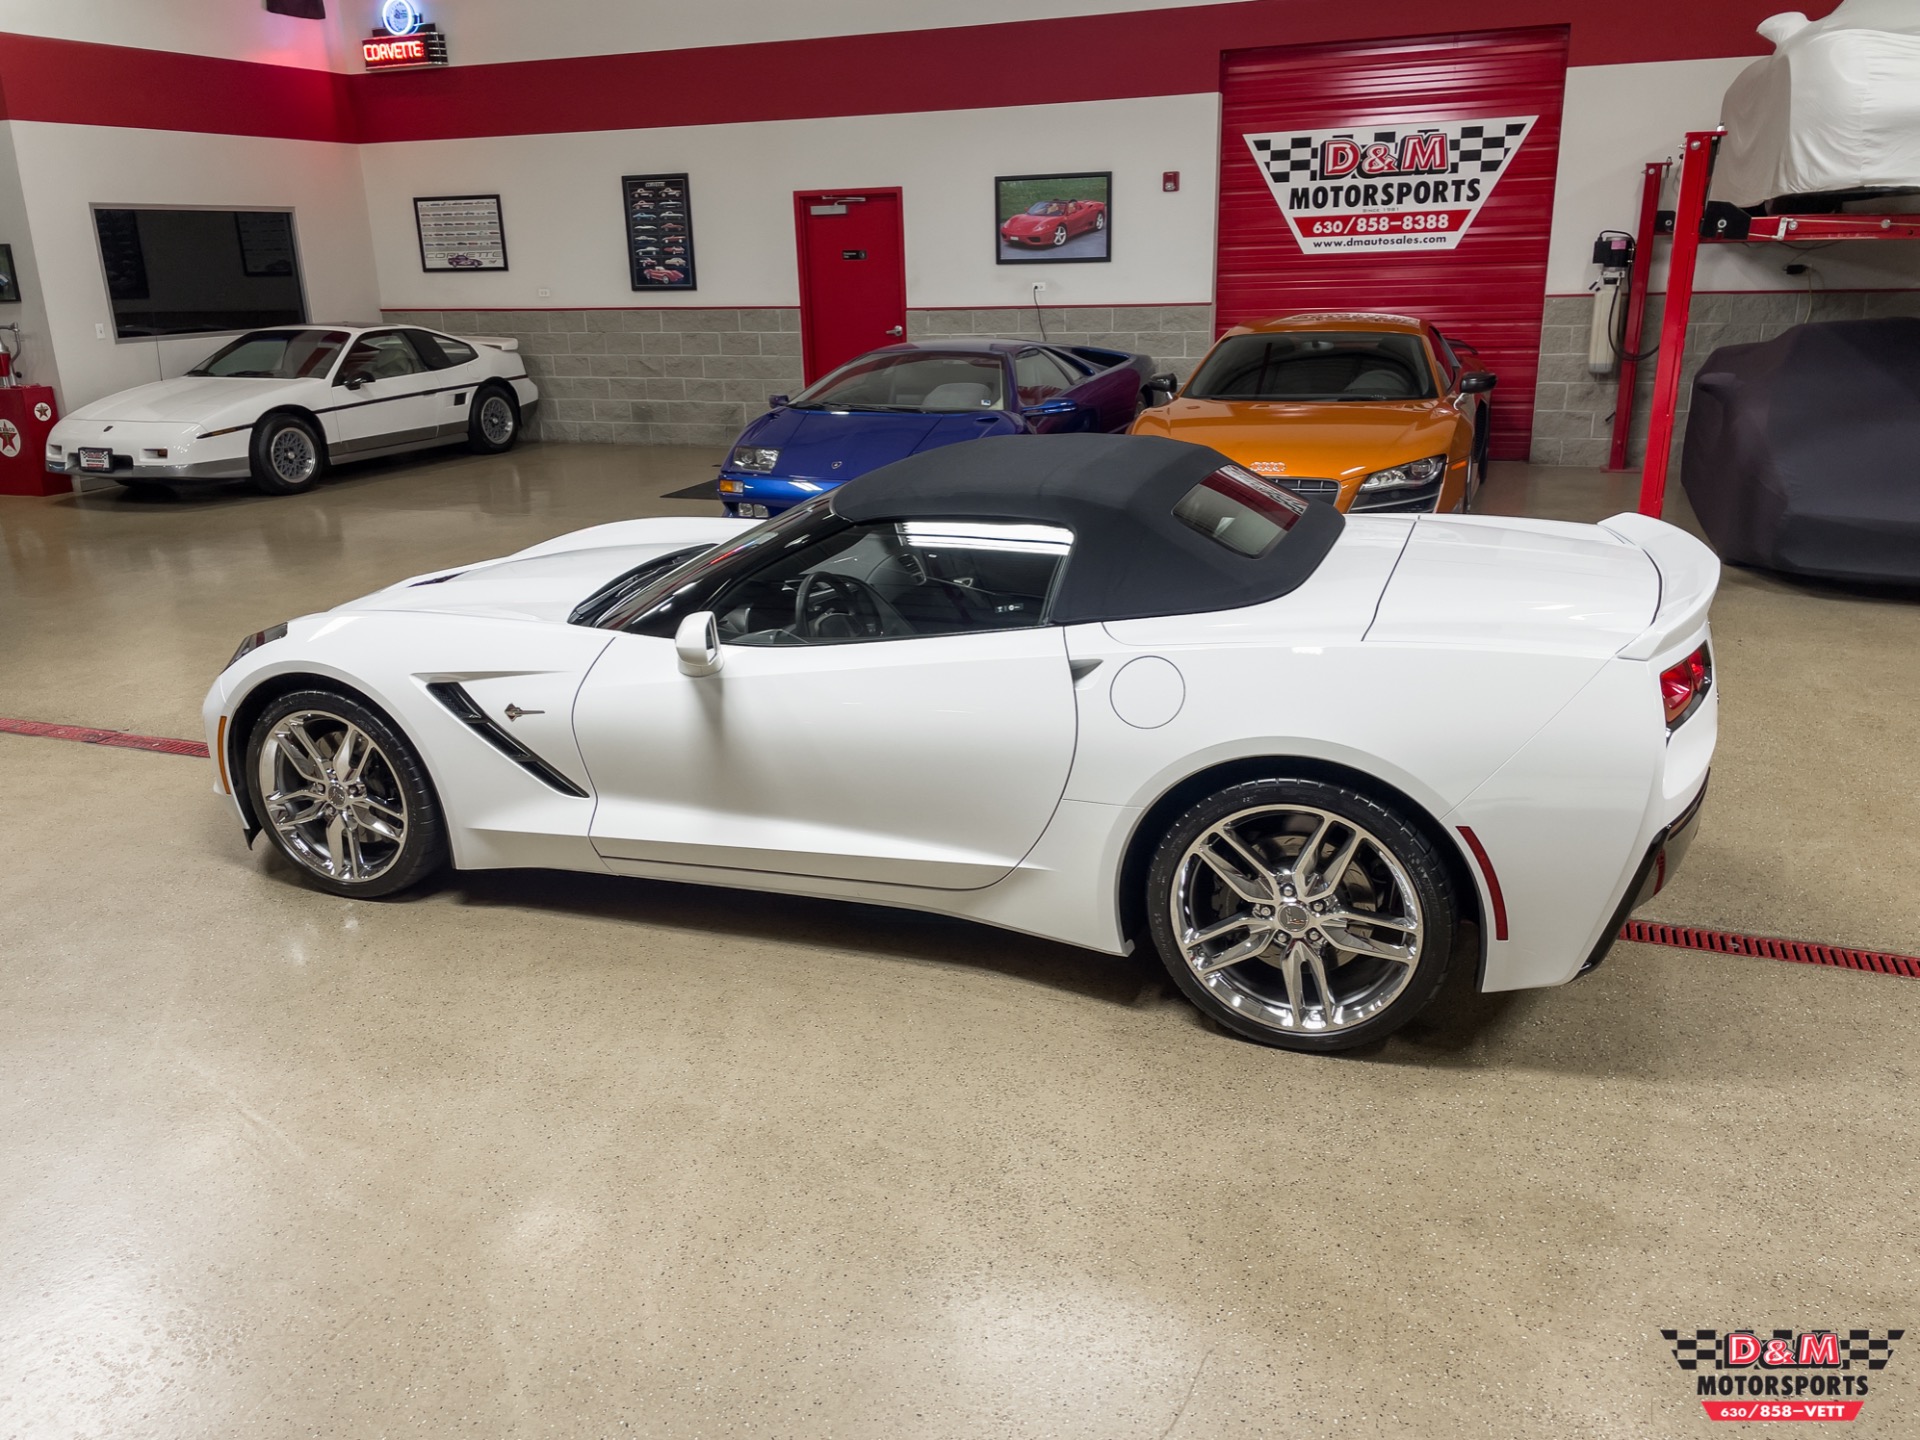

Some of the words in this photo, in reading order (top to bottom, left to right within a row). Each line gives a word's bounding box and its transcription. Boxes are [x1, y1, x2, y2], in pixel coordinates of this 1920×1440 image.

[363, 41, 423, 61] CORVETTE
[1320, 132, 1449, 179] D&M
[1289, 178, 1480, 210] MOTORSPORTS
[1313, 214, 1449, 234] 630/858-8388
[1313, 235, 1446, 248] www.dmautosales.com
